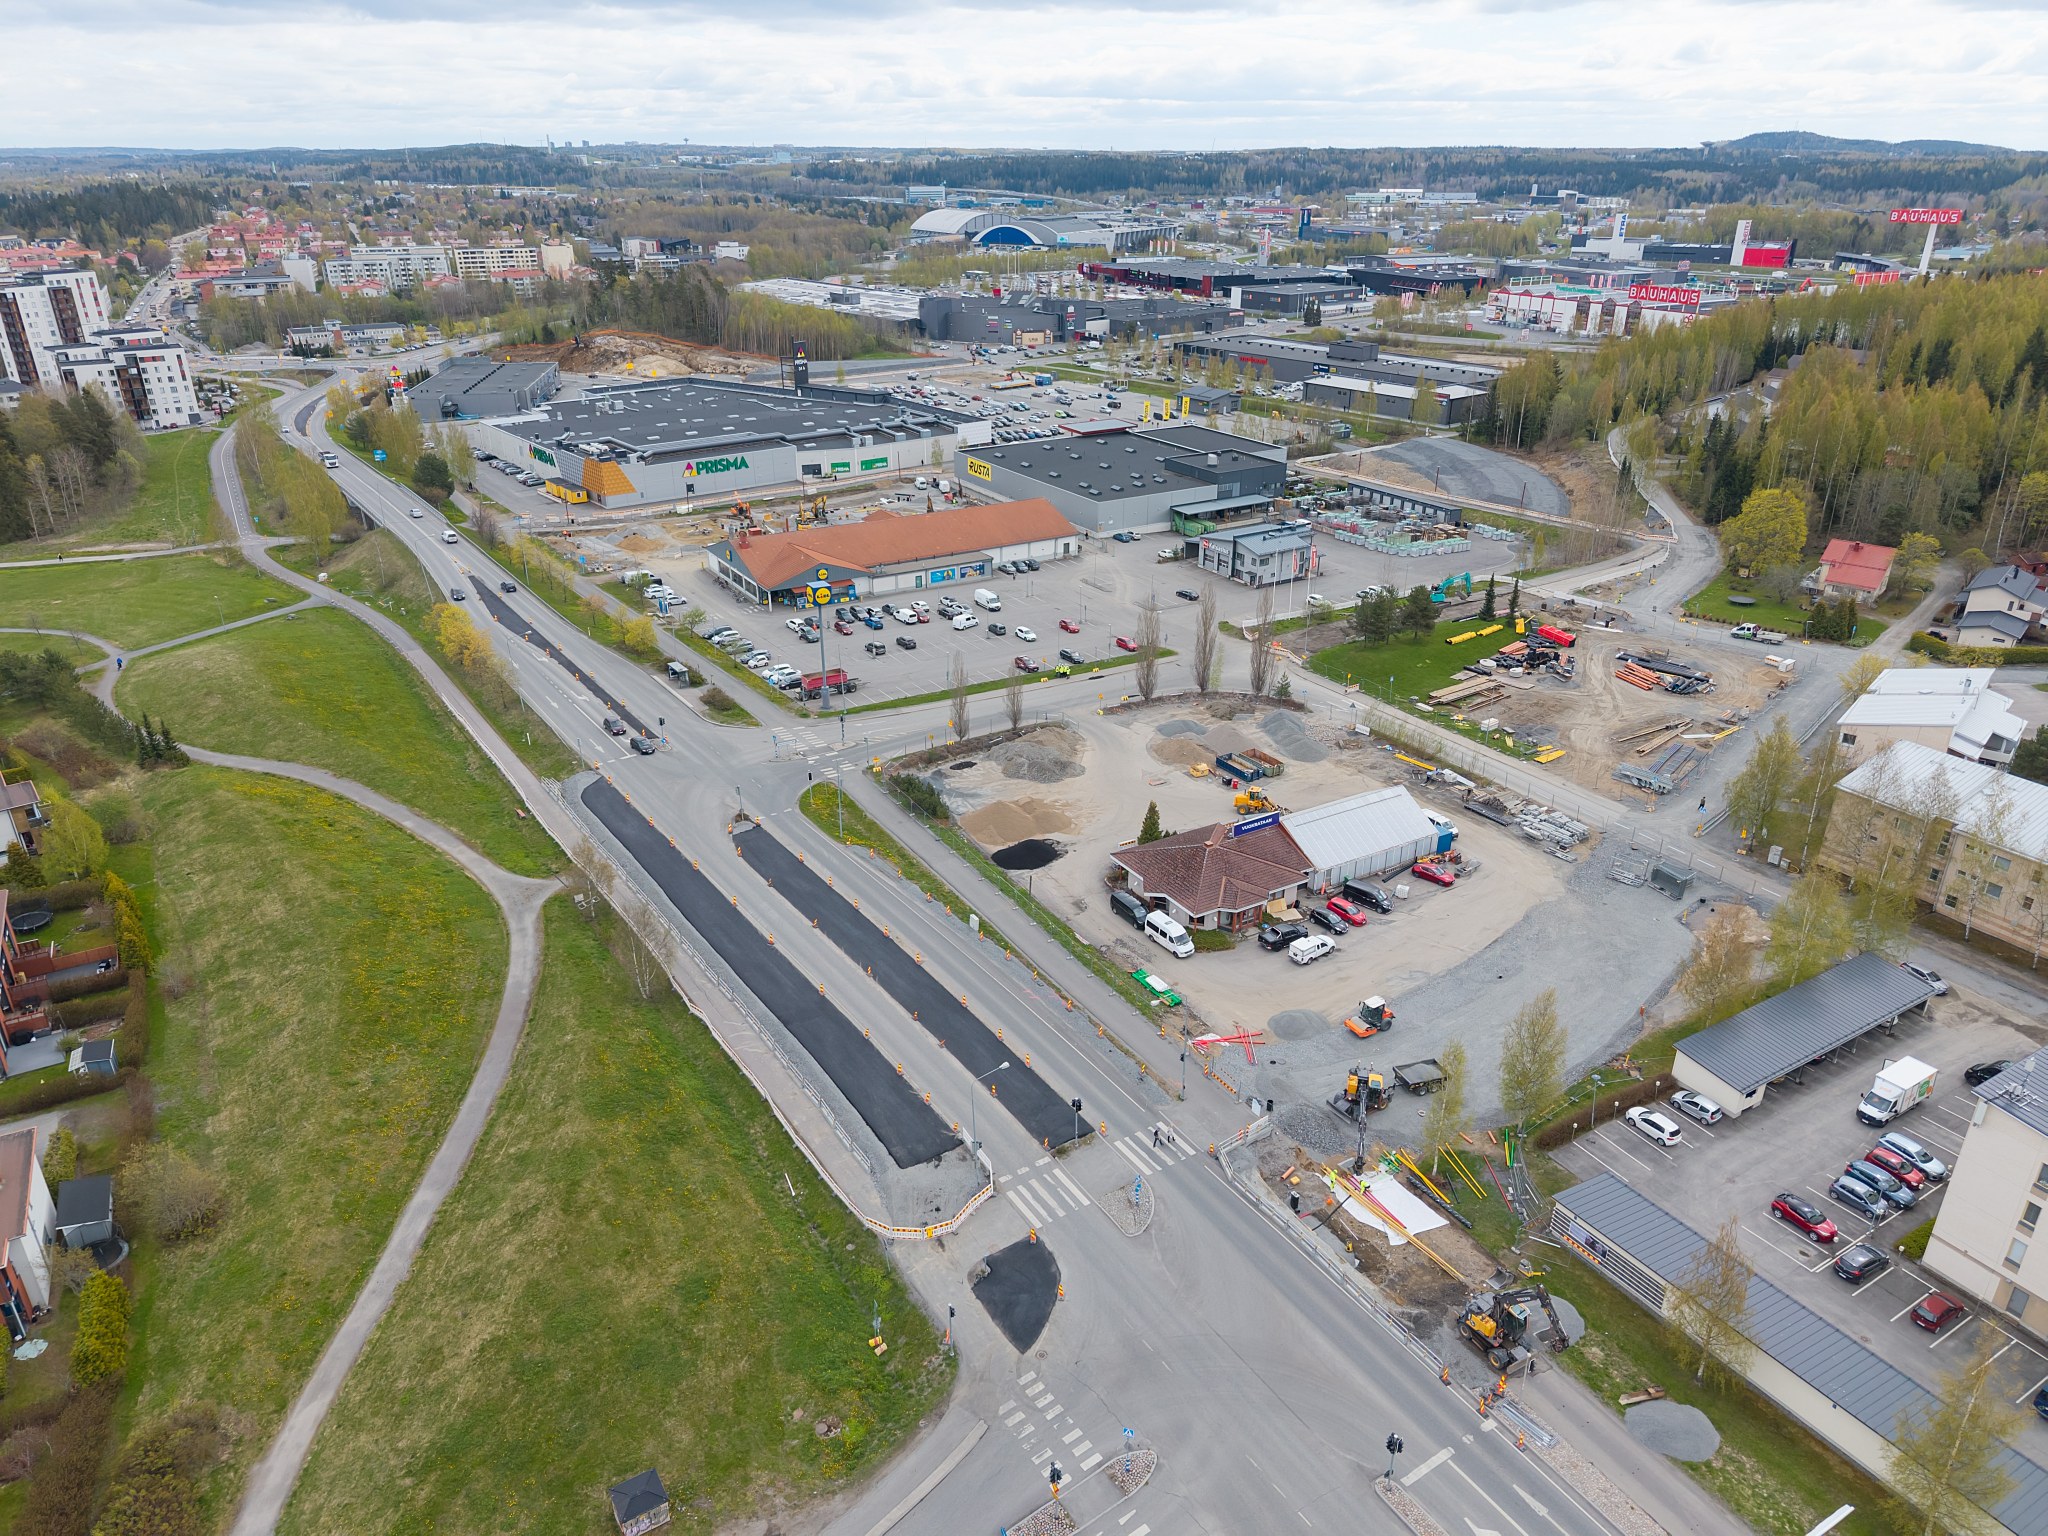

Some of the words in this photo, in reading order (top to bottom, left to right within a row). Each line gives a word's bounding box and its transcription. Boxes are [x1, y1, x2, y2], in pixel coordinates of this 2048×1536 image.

[1890, 211, 1959, 223] BAUHAUS
[1630, 287, 1699, 303] BAUHAUS
[696, 456, 749, 475] PRISMA
[969, 461, 990, 478] RUSTA
